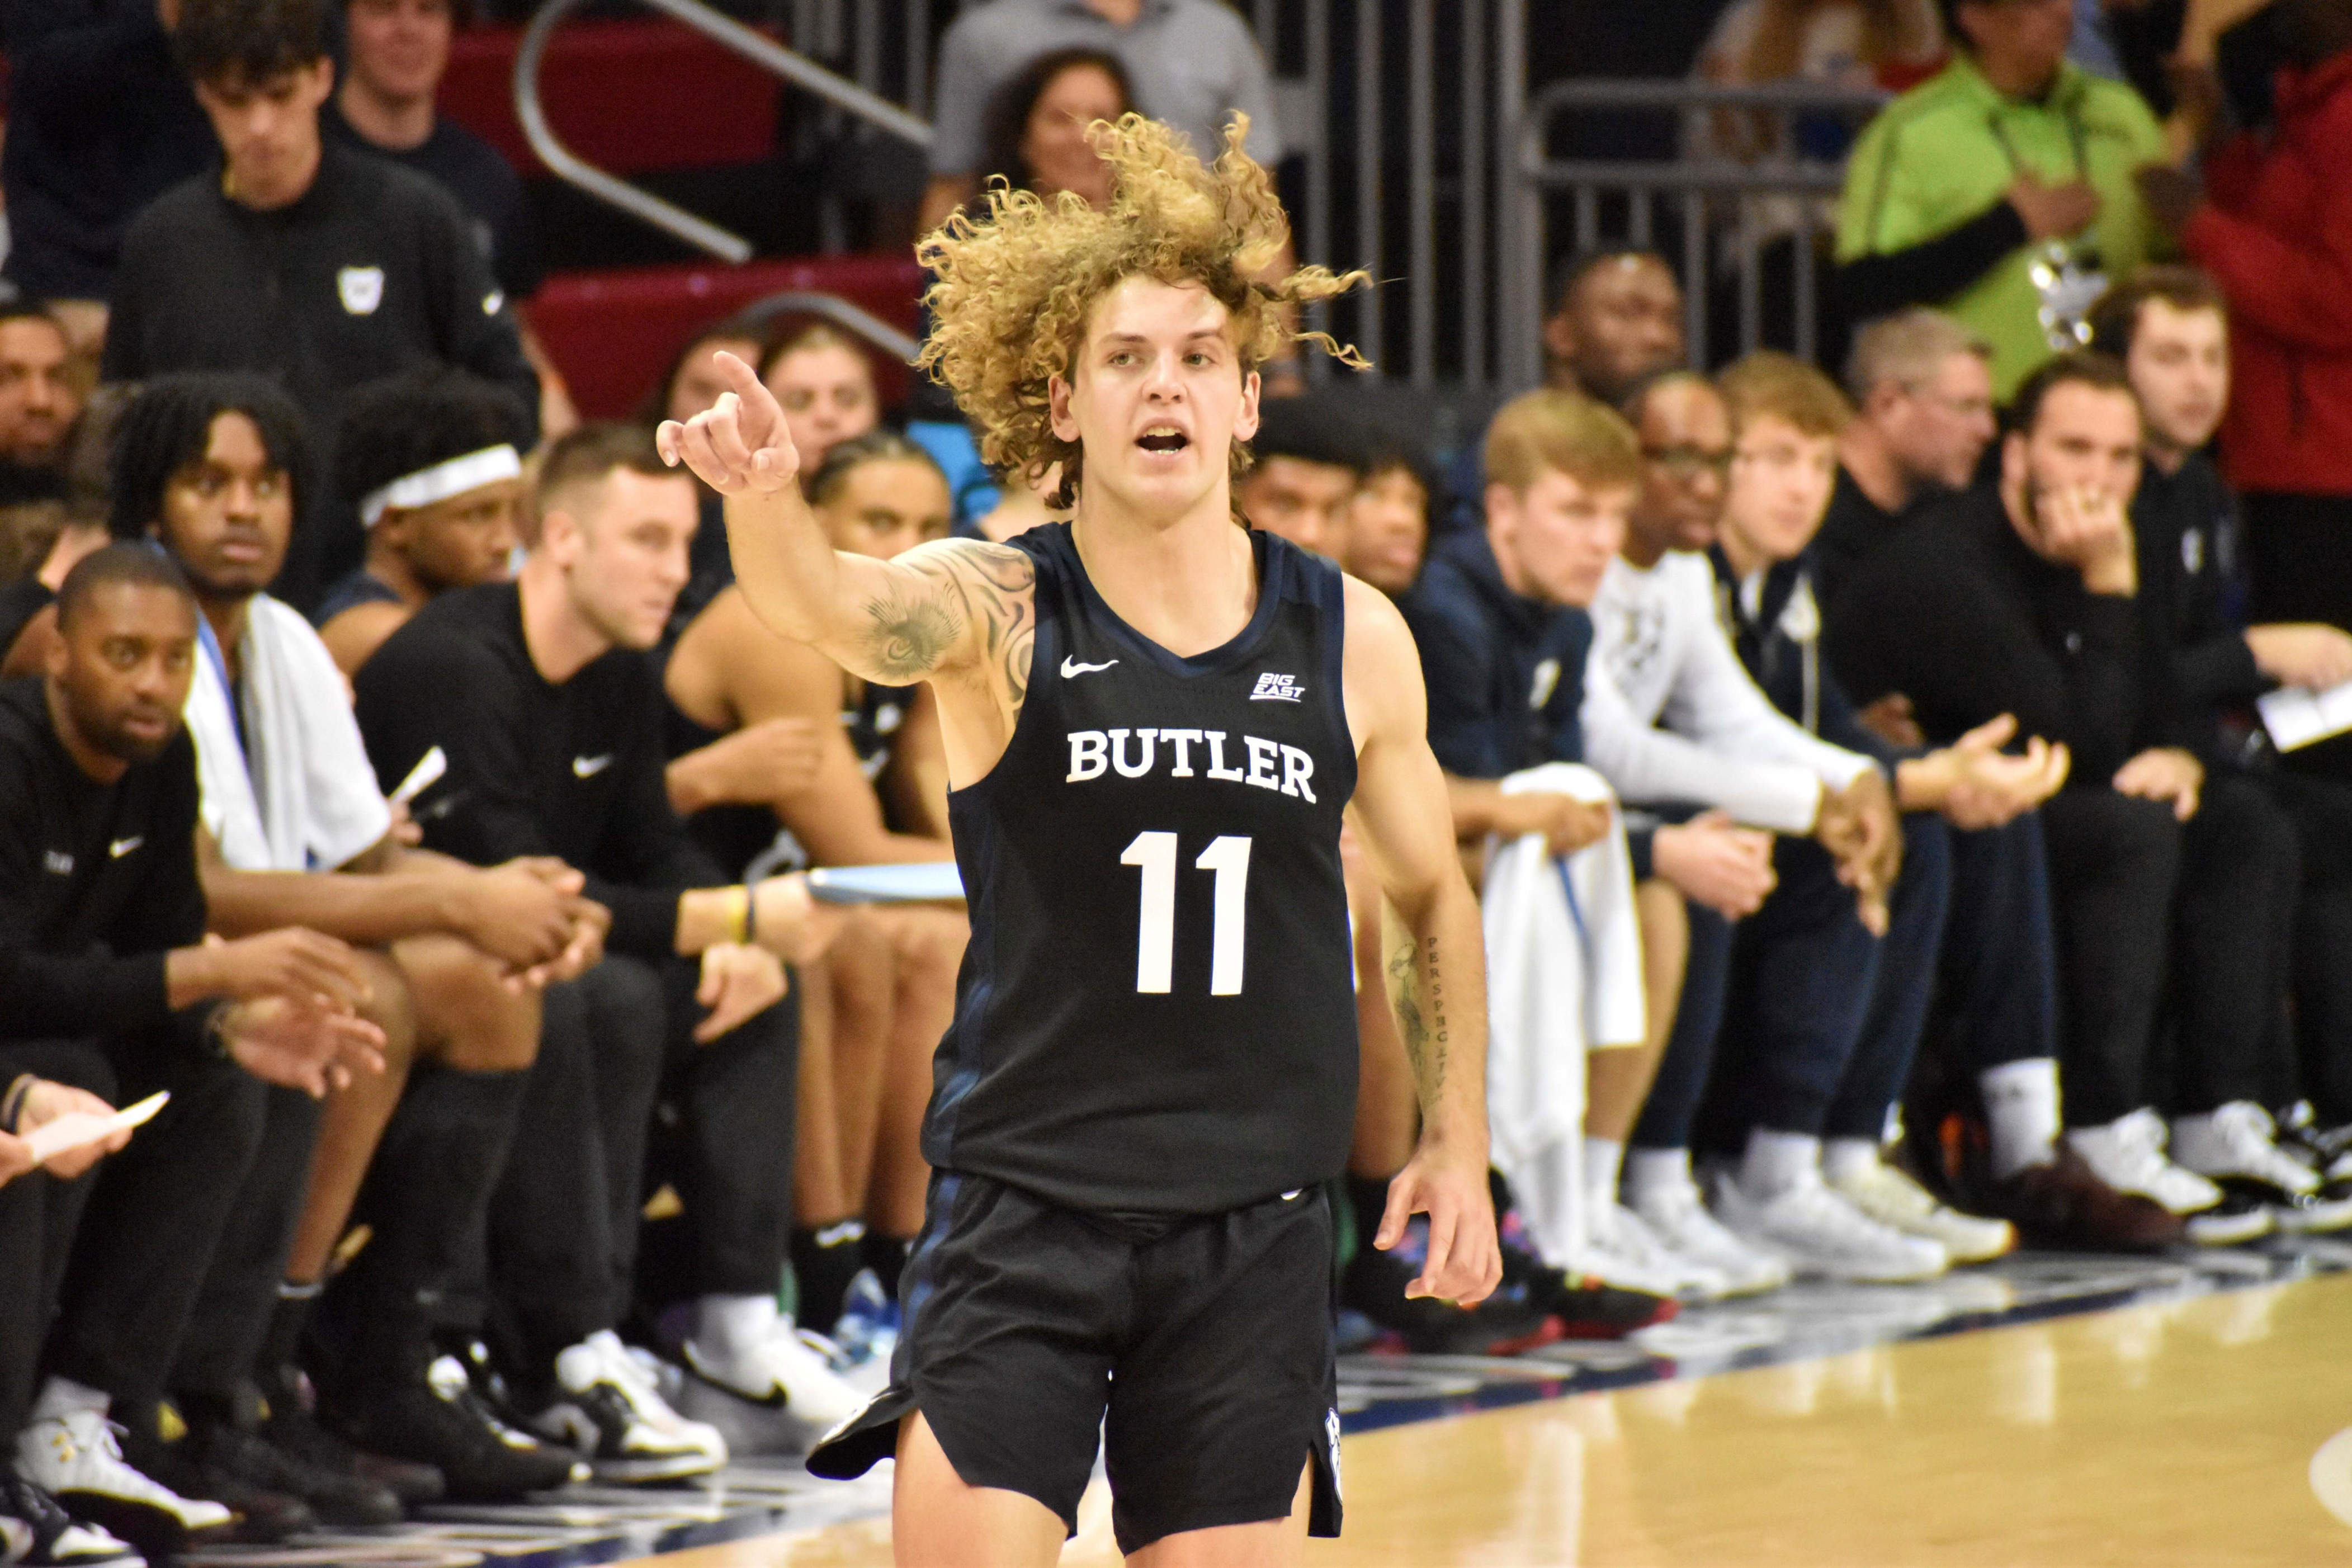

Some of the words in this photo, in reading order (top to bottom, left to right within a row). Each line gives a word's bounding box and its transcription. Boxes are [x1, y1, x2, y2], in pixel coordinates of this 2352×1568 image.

[1253, 683, 1305, 698] EAST
[1258, 672, 1296, 686] BIG
[1066, 728, 1316, 804] BUTLER
[1121, 831, 1251, 995] 11
